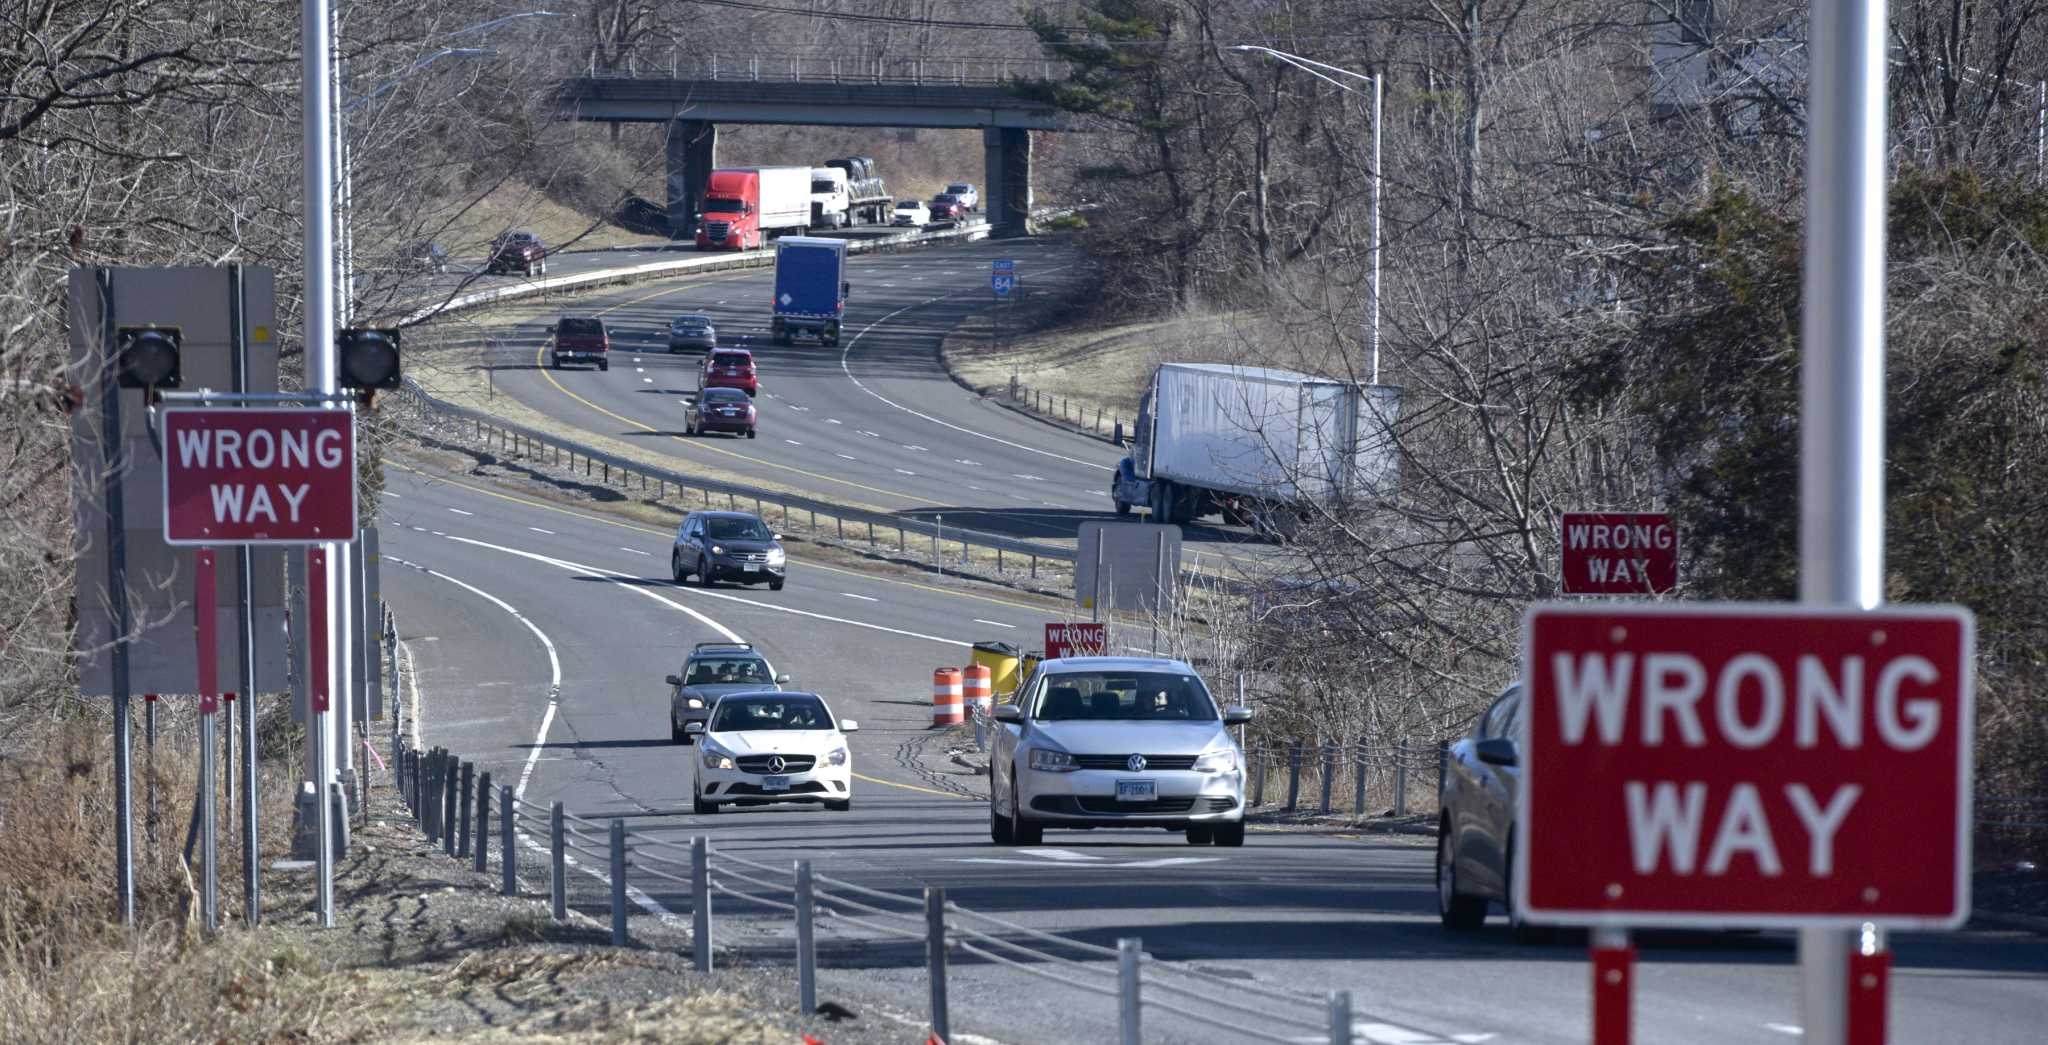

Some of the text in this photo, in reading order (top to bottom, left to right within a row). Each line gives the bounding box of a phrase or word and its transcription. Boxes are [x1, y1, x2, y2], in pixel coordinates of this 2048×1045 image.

[995, 278, 1011, 289] 84
[176, 429, 342, 468] WRONG
[210, 484, 310, 523] WAY
[1568, 524, 1672, 550] WRONG
[1588, 558, 1650, 583] WAY
[1048, 628, 1105, 642] WRONG
[1552, 652, 1941, 751] WRONG
[1624, 781, 1863, 877] WAY
